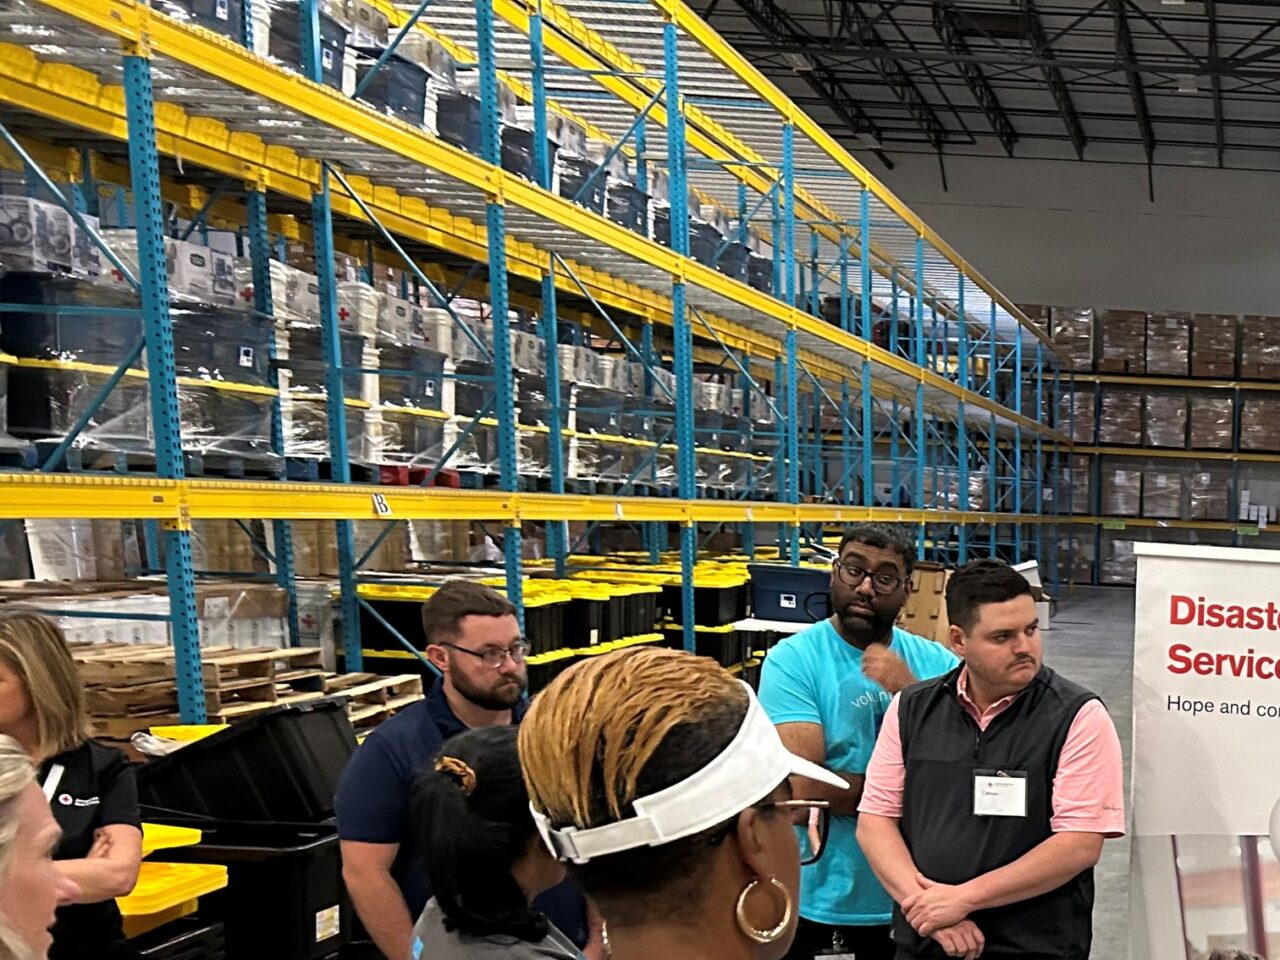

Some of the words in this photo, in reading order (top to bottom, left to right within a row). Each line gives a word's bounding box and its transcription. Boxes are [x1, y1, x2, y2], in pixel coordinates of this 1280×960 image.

[375, 494, 388, 514] B
[1167, 695, 1215, 714] Hope
[1219, 699, 1251, 716] and
